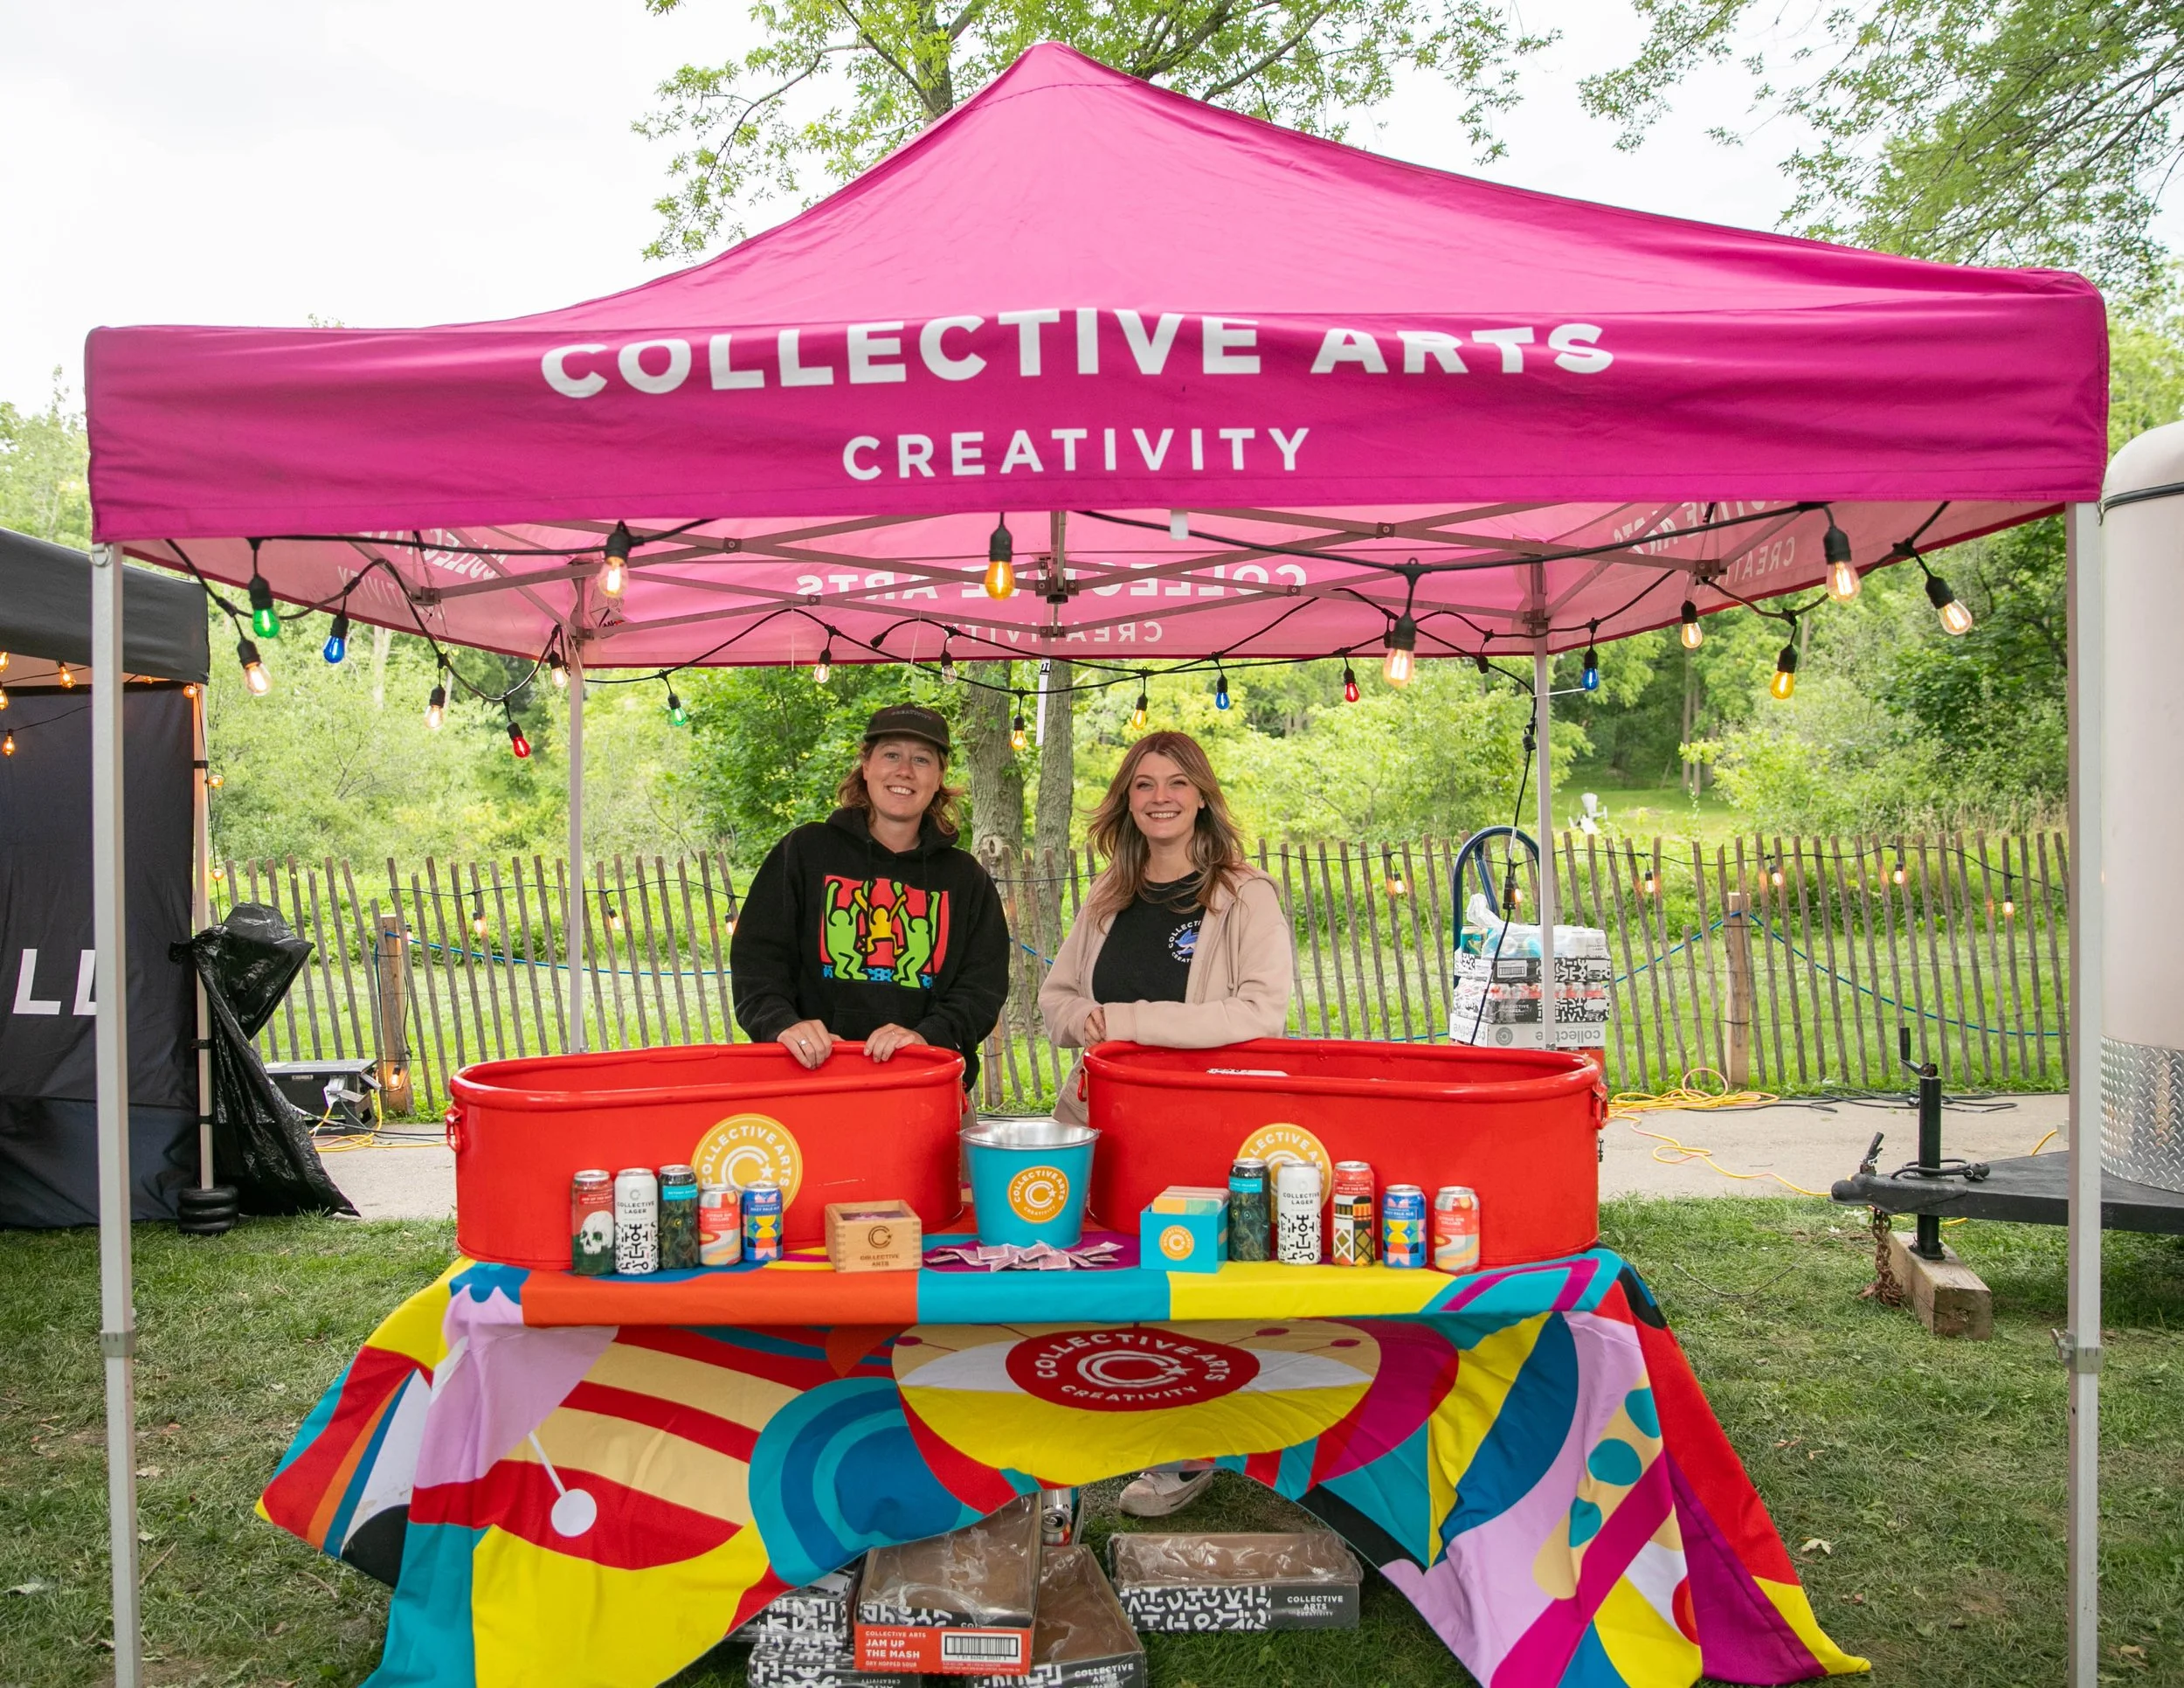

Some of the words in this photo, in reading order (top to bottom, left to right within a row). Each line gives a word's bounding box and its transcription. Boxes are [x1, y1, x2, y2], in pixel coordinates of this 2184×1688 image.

[541, 308, 1261, 398] COLLECTIVE
[1310, 323, 1614, 374] ARTS
[842, 428, 1310, 480] CREATIVITY
[1535, 1029, 1600, 1044] collecte
[702, 1125, 777, 1185] COLLECTIVE
[775, 1145, 791, 1187] ARTS
[1013, 1170, 1058, 1203] COLLECTIVE
[1056, 1178, 1065, 1200] ARTS
[1035, 1333, 1199, 1379] COLLECTIVE
[1193, 1353, 1230, 1381] ARTS
[1061, 1385, 1198, 1401] CREATIVITY
[866, 1649, 887, 1657] THE
[1074, 1663, 1134, 1678] COLLECTIVE
